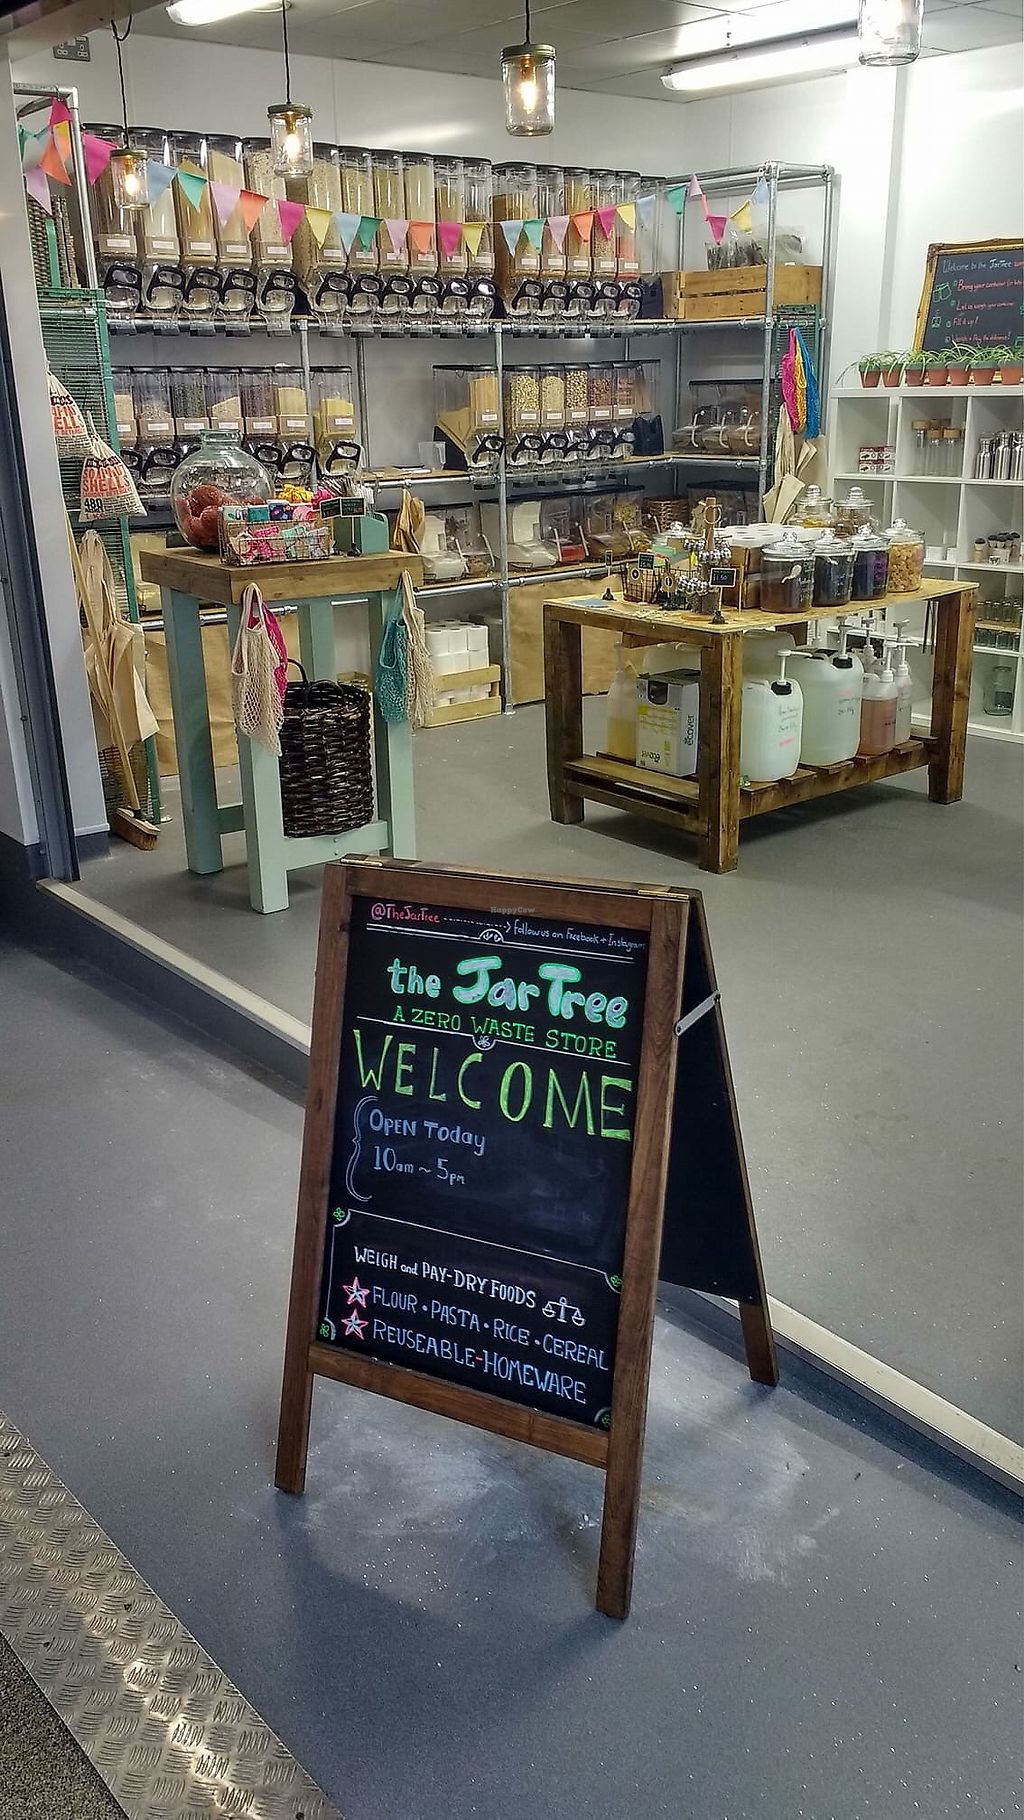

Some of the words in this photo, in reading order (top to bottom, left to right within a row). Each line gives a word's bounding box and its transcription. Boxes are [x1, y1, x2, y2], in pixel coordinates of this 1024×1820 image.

[83, 475, 130, 492] SHELLS
[684, 714, 695, 746] ecover
[371, 902, 440, 923] @TheJarTree
[551, 931, 563, 939] on
[566, 928, 599, 944] Facebook
[607, 933, 646, 952] Instagram
[387, 957, 441, 998] the
[393, 1005, 406, 1023] A
[412, 1008, 462, 1031] ZERO
[471, 1016, 536, 1043] WASTE
[545, 1029, 617, 1059] STORE
[353, 1029, 633, 1141] WELCOME
[369, 1108, 417, 1136] OPEN
[423, 1120, 485, 1156] Today
[373, 1146, 414, 1173] 10am
[437, 1158, 465, 1185] 5pm
[353, 1246, 397, 1270] WEIGH
[400, 1262, 418, 1276] and
[490, 1281, 536, 1308] FOODS
[372, 1286, 418, 1314] FLOUR
[431, 1300, 480, 1332] PASTA
[493, 1318, 530, 1346] RICE
[542, 1334, 609, 1371] CEREAL
